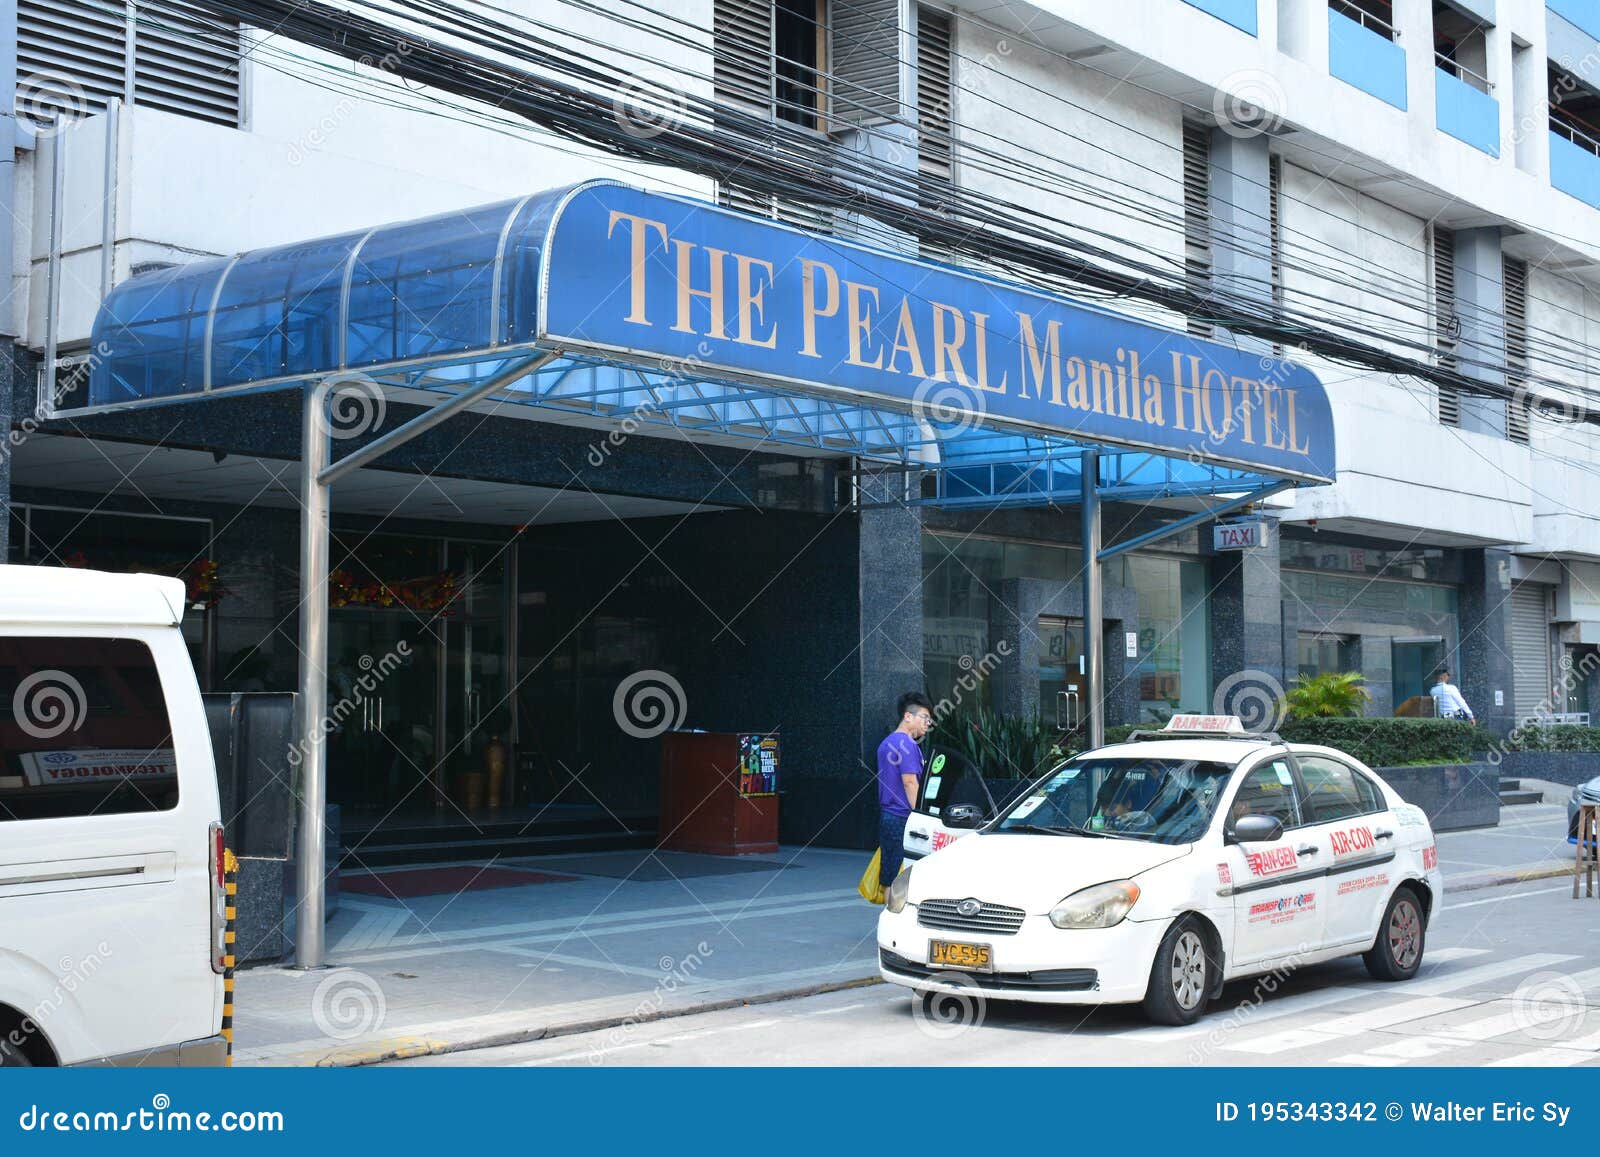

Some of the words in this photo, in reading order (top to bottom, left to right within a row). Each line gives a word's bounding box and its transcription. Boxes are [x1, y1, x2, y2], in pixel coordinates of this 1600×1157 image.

[607, 210, 777, 350] THE
[798, 256, 1008, 395] PEARL
[1015, 311, 1166, 428] Manila
[1169, 350, 1310, 456] HOTEL
[1220, 527, 1255, 546] TAXI
[1329, 826, 1375, 856] AIR-CON
[1246, 846, 1298, 876] RAN-GEN
[961, 945, 989, 964] 595
